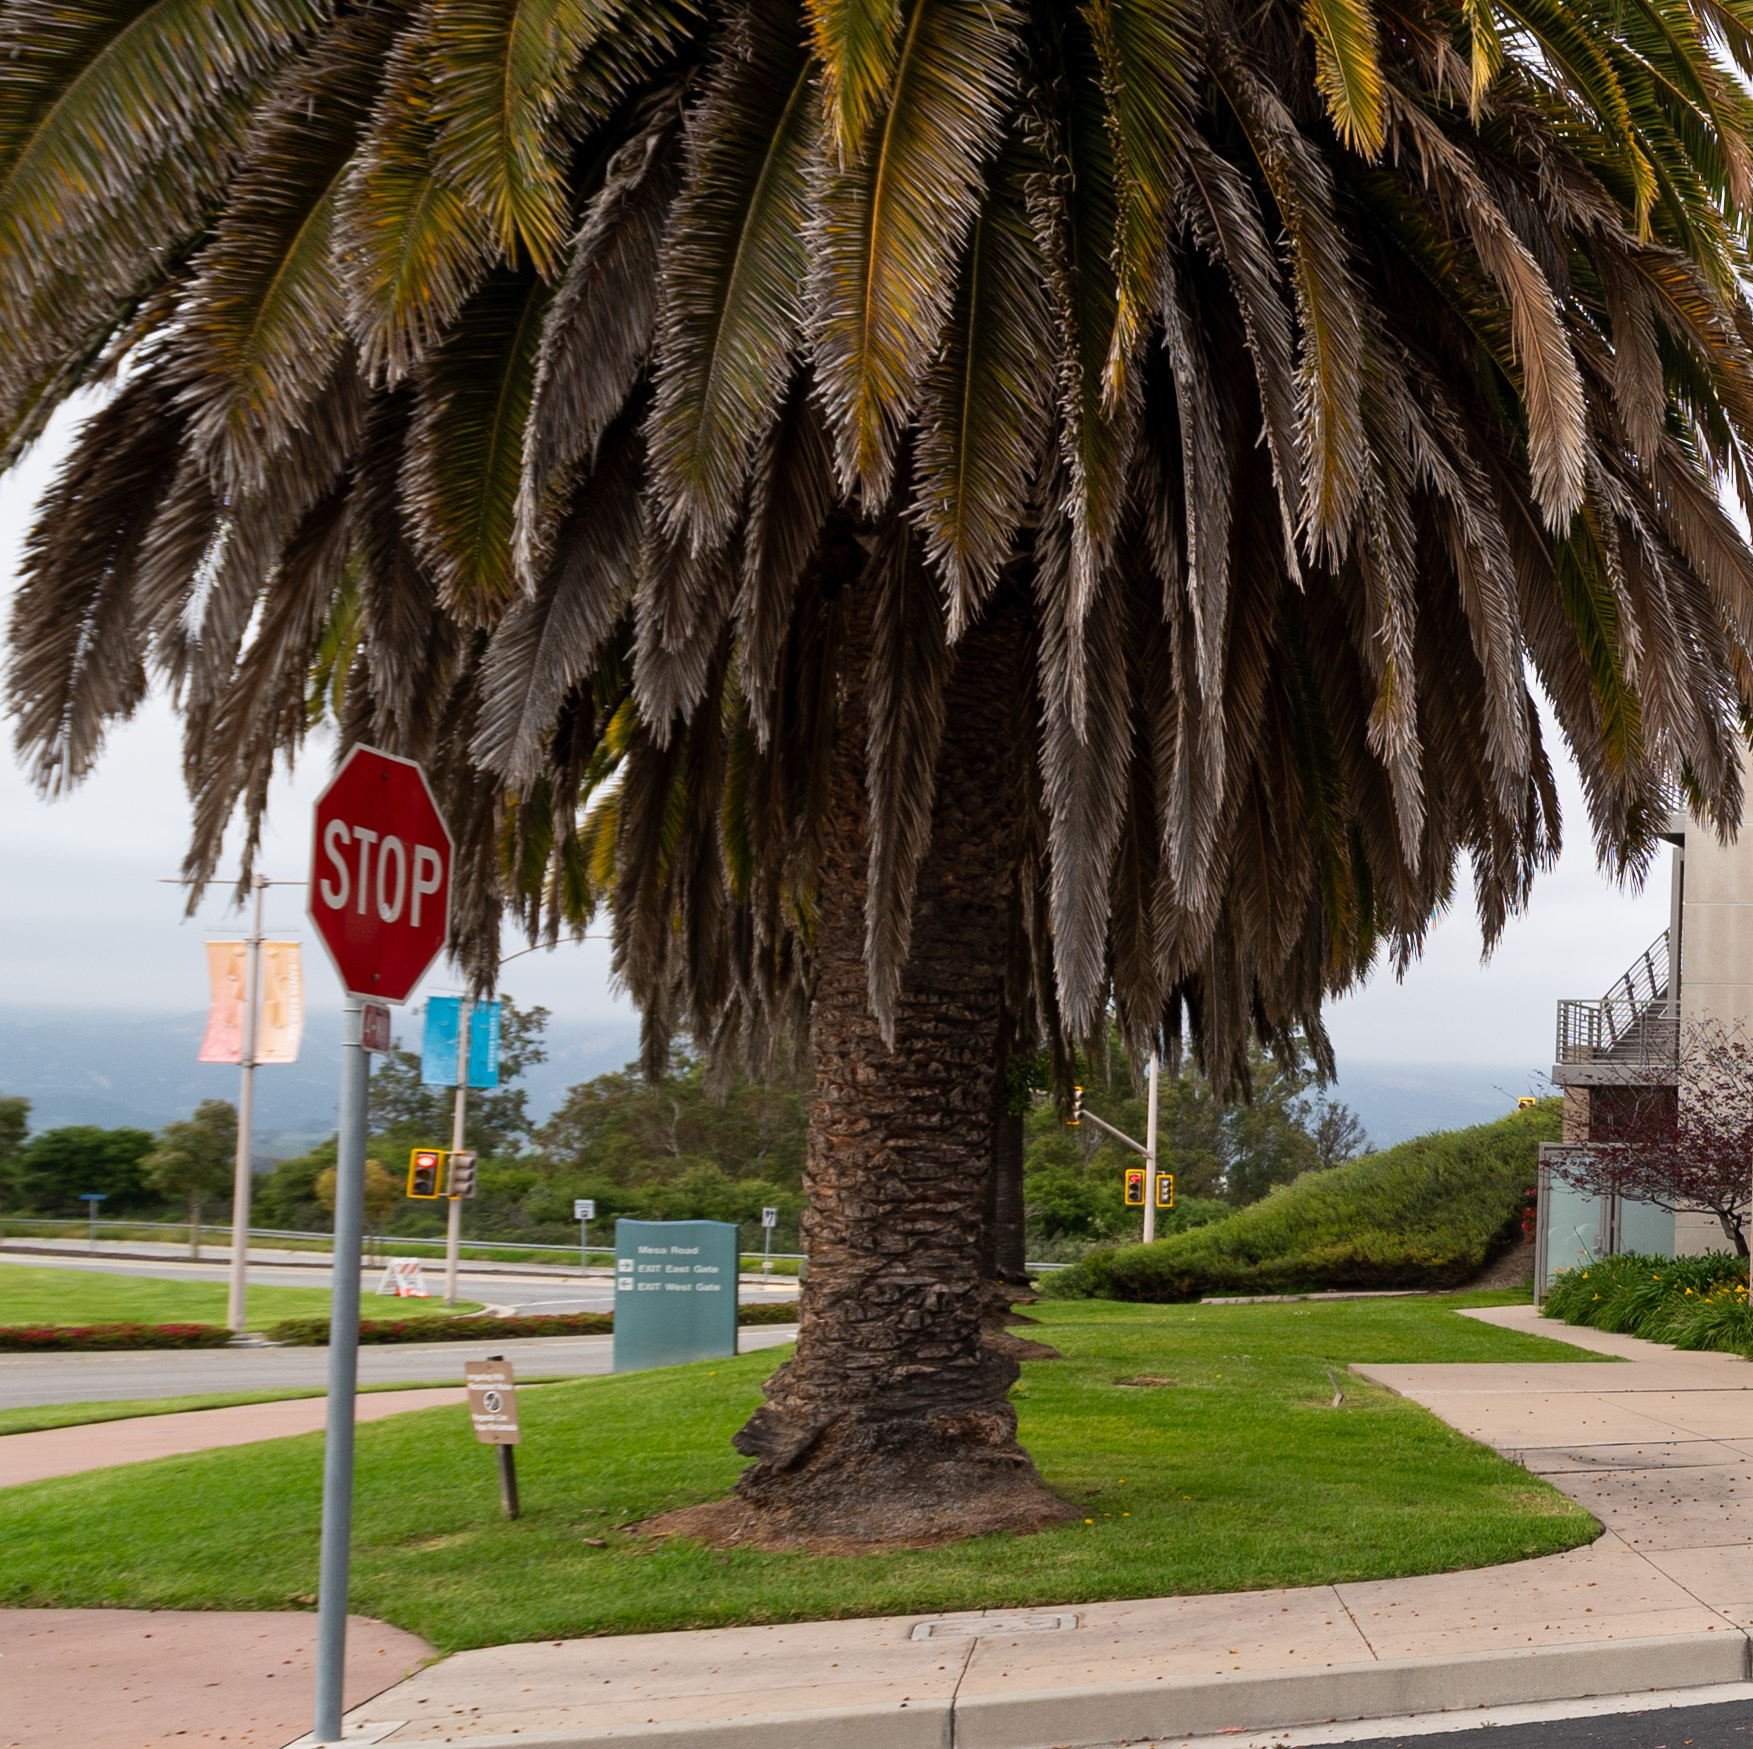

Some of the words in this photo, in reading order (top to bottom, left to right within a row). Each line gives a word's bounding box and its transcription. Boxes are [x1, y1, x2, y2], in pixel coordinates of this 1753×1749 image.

[320, 819, 443, 928] STOP
[638, 1246, 667, 1255] Mesa
[670, 1246, 699, 1255] Road
[637, 1265, 662, 1273] EXIT
[665, 1265, 690, 1274] East
[693, 1265, 719, 1274] Gate
[637, 1283, 662, 1291] EXIT
[664, 1283, 692, 1292] West
[695, 1283, 721, 1292] Gate
